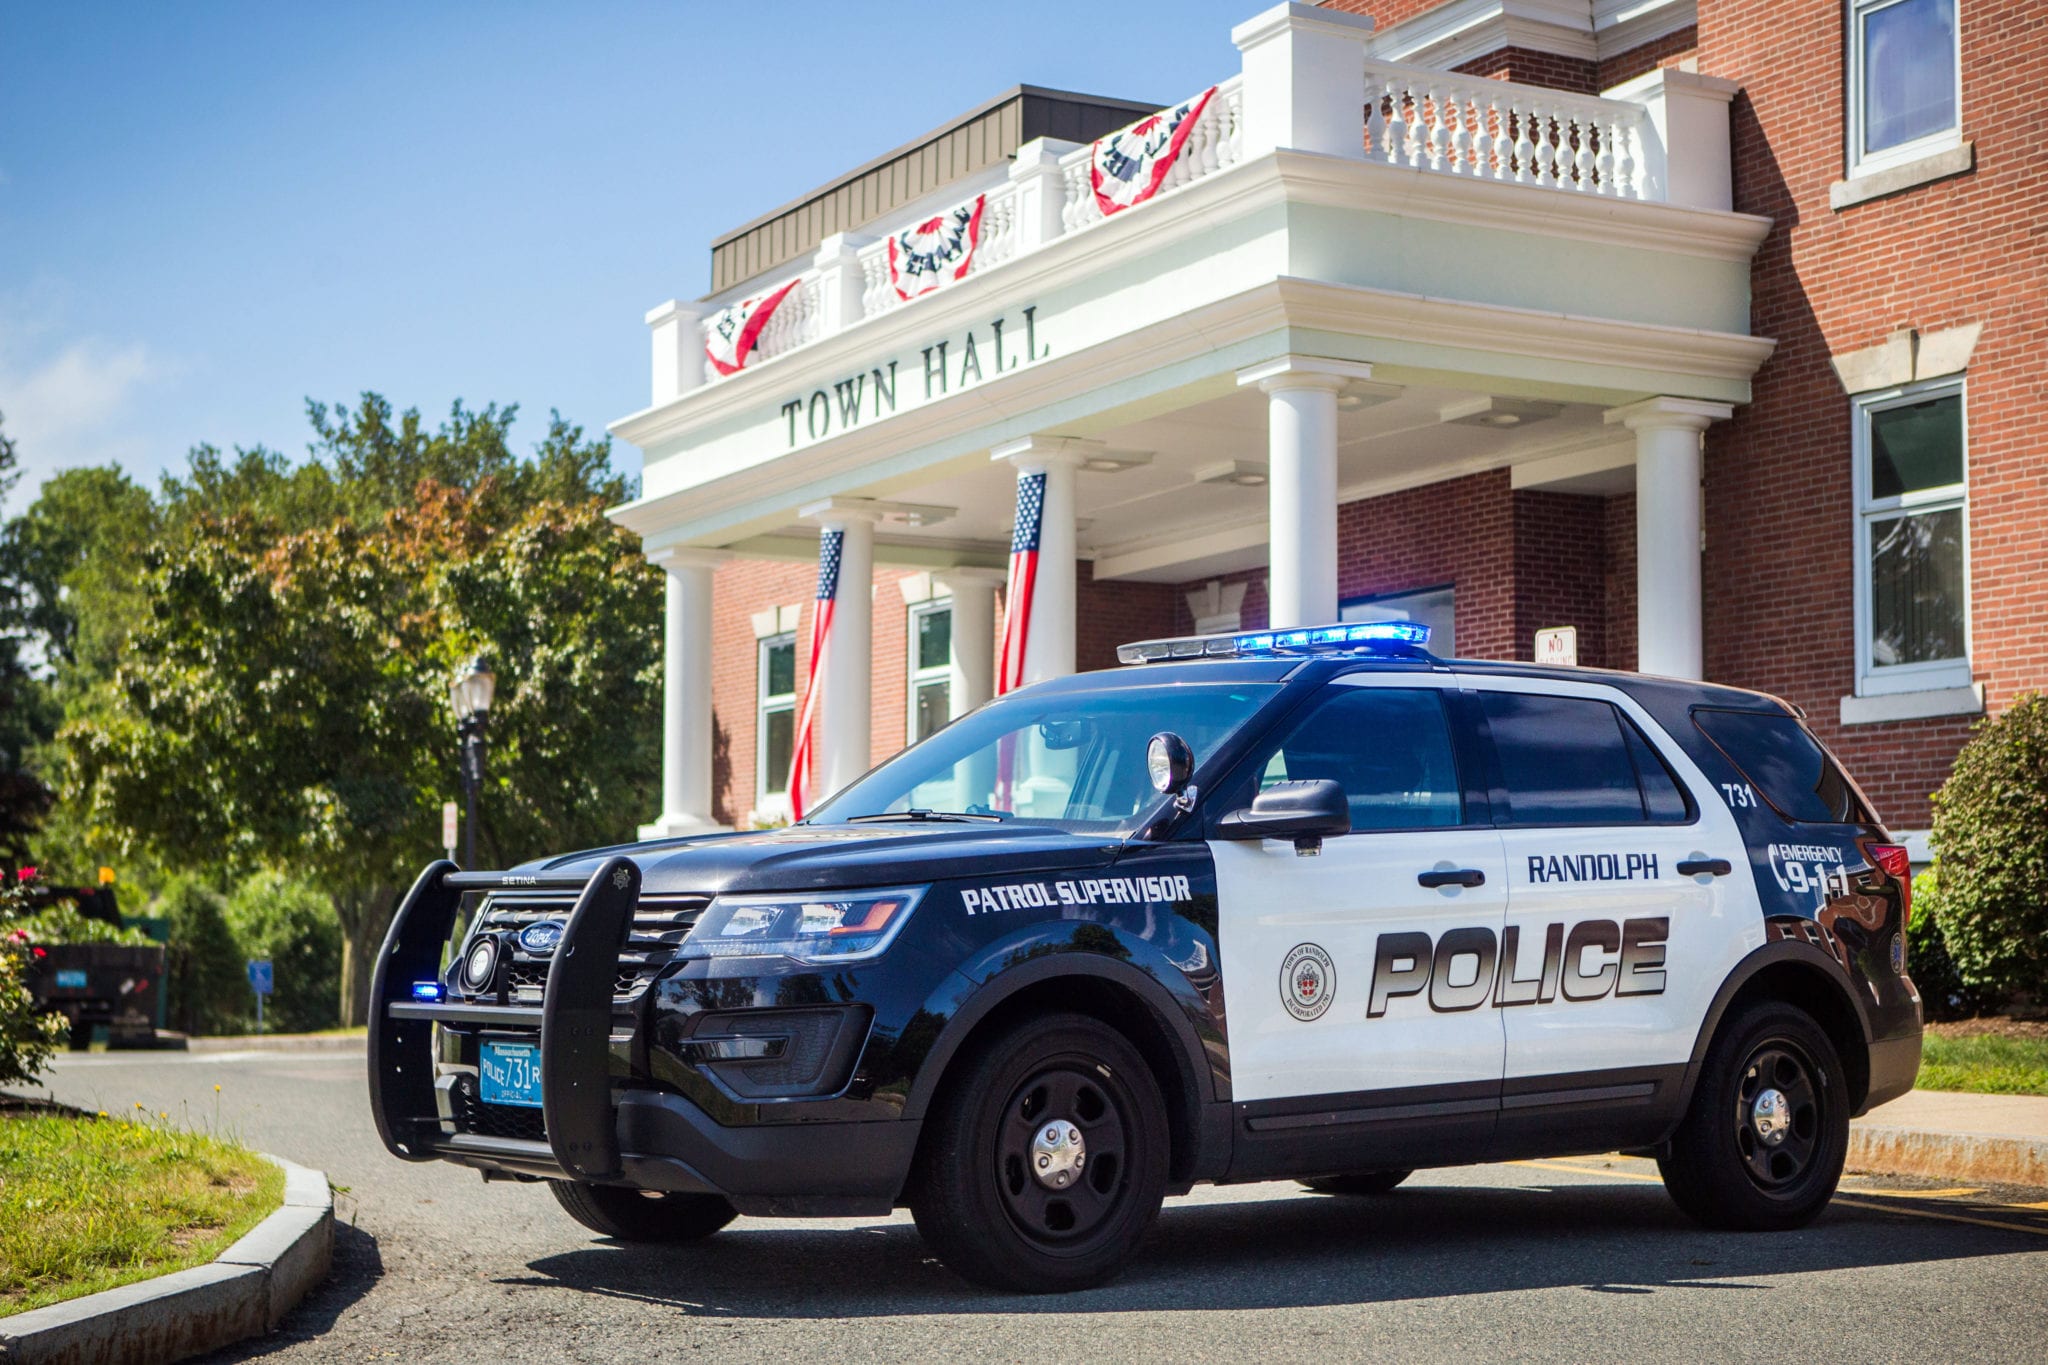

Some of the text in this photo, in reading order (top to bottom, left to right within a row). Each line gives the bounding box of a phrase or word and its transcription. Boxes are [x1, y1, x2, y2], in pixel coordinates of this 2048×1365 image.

[782, 305, 1049, 447] TOWN HALL
[1548, 638, 1563, 653] NO
[1722, 783, 1757, 808] 731
[1779, 843, 1843, 863] EMERGENCY
[1527, 853, 1659, 883] RANDOLPH
[1785, 861, 1850, 896] 9-1-1
[502, 876, 537, 886] SETINA
[960, 875, 1193, 916] PATROL SUPERVISOR
[525, 929, 554, 946] Ford
[1285, 945, 1331, 970] TOWN OF RANDOLPH
[1366, 916, 1670, 1019] POLICE
[1286, 998, 1323, 1018] INCORPORATED
[483, 1058, 505, 1087] POLICE
